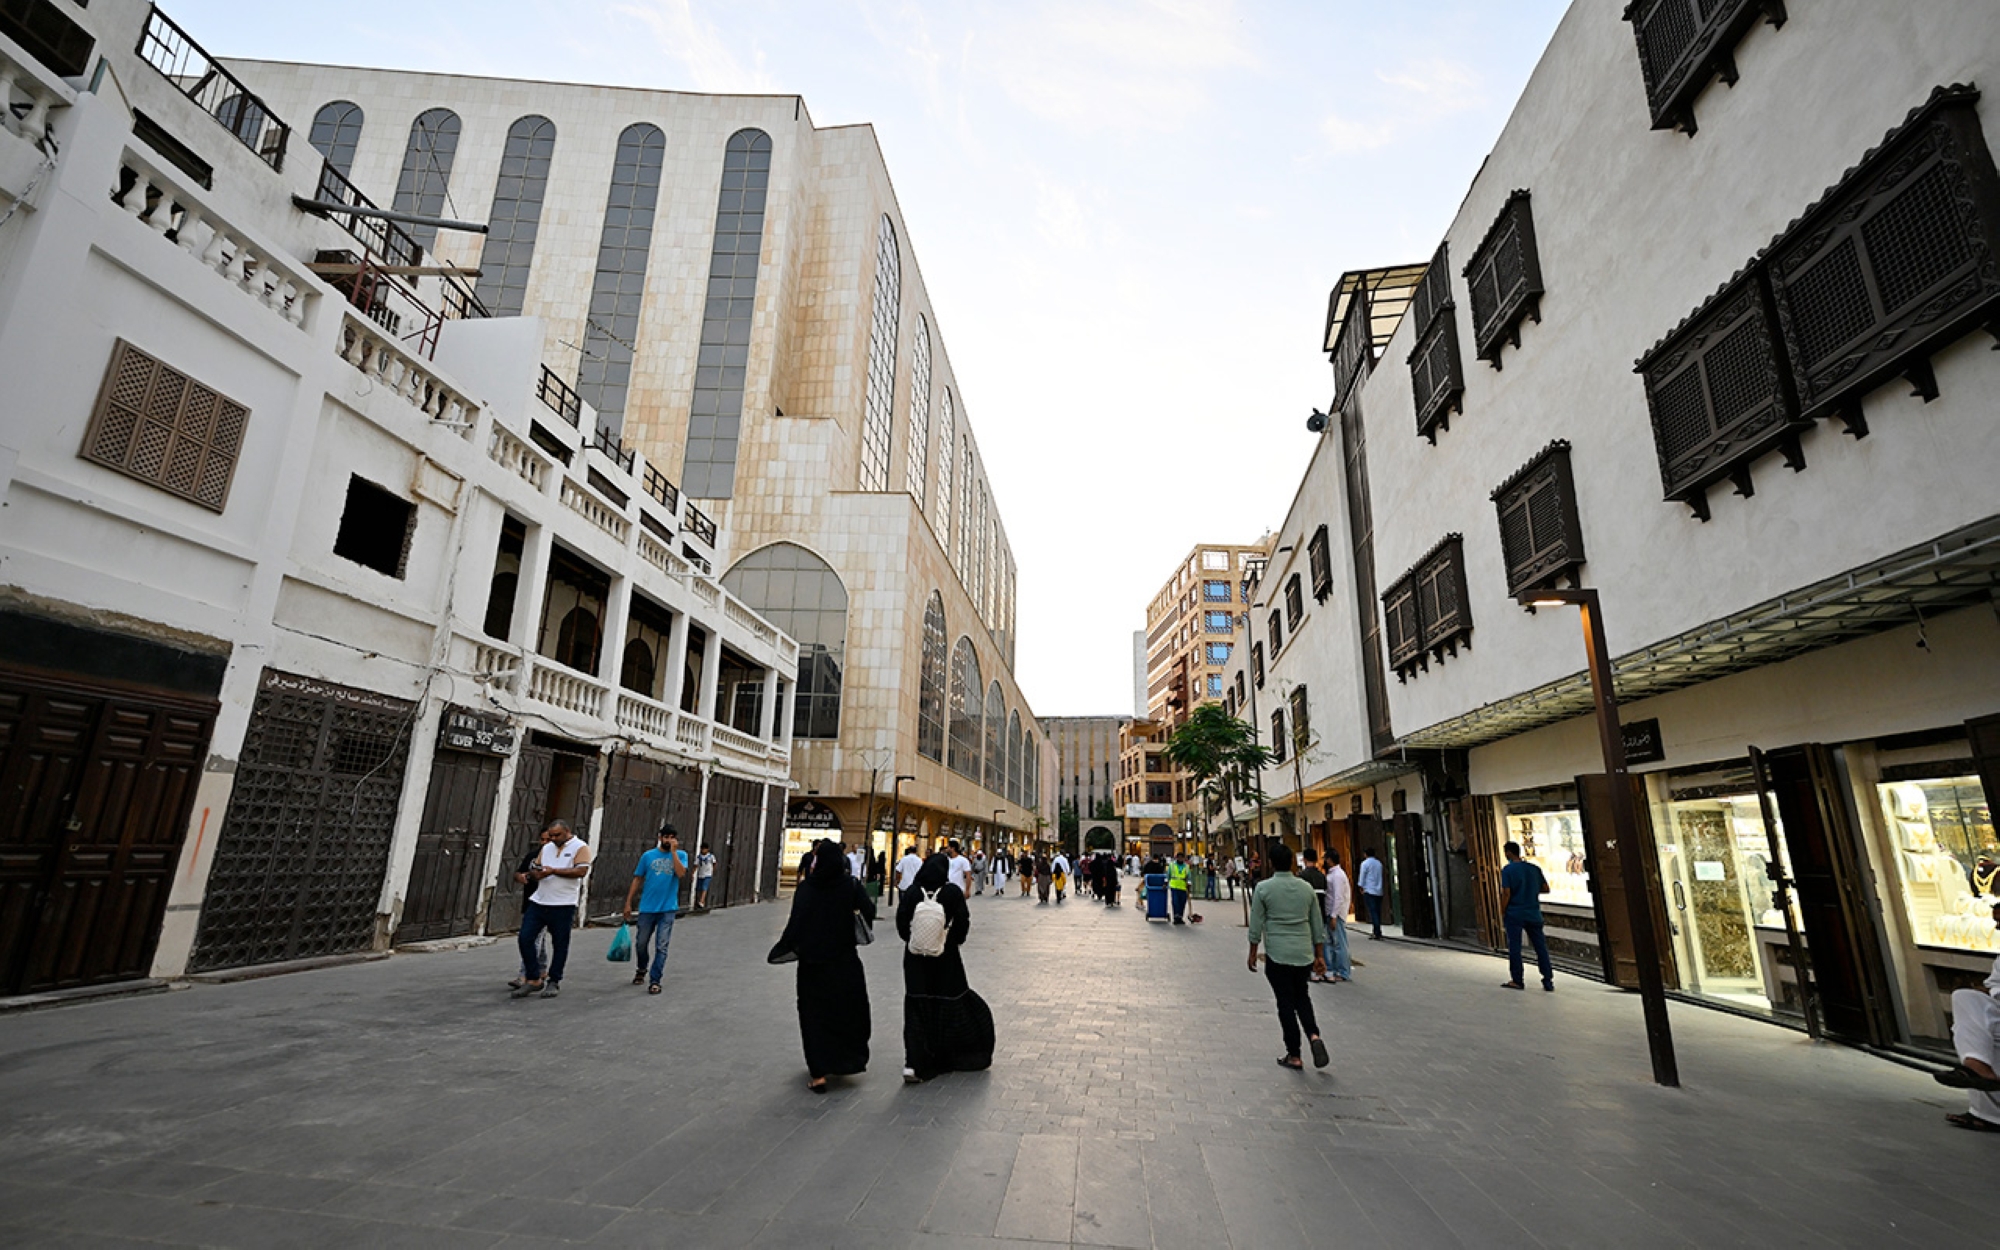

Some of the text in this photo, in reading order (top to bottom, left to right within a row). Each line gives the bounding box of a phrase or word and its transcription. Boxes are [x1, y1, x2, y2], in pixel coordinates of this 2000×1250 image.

[321, 685, 336, 697] بن
[335, 689, 360, 702] صالح
[475, 730, 494, 745] 925
